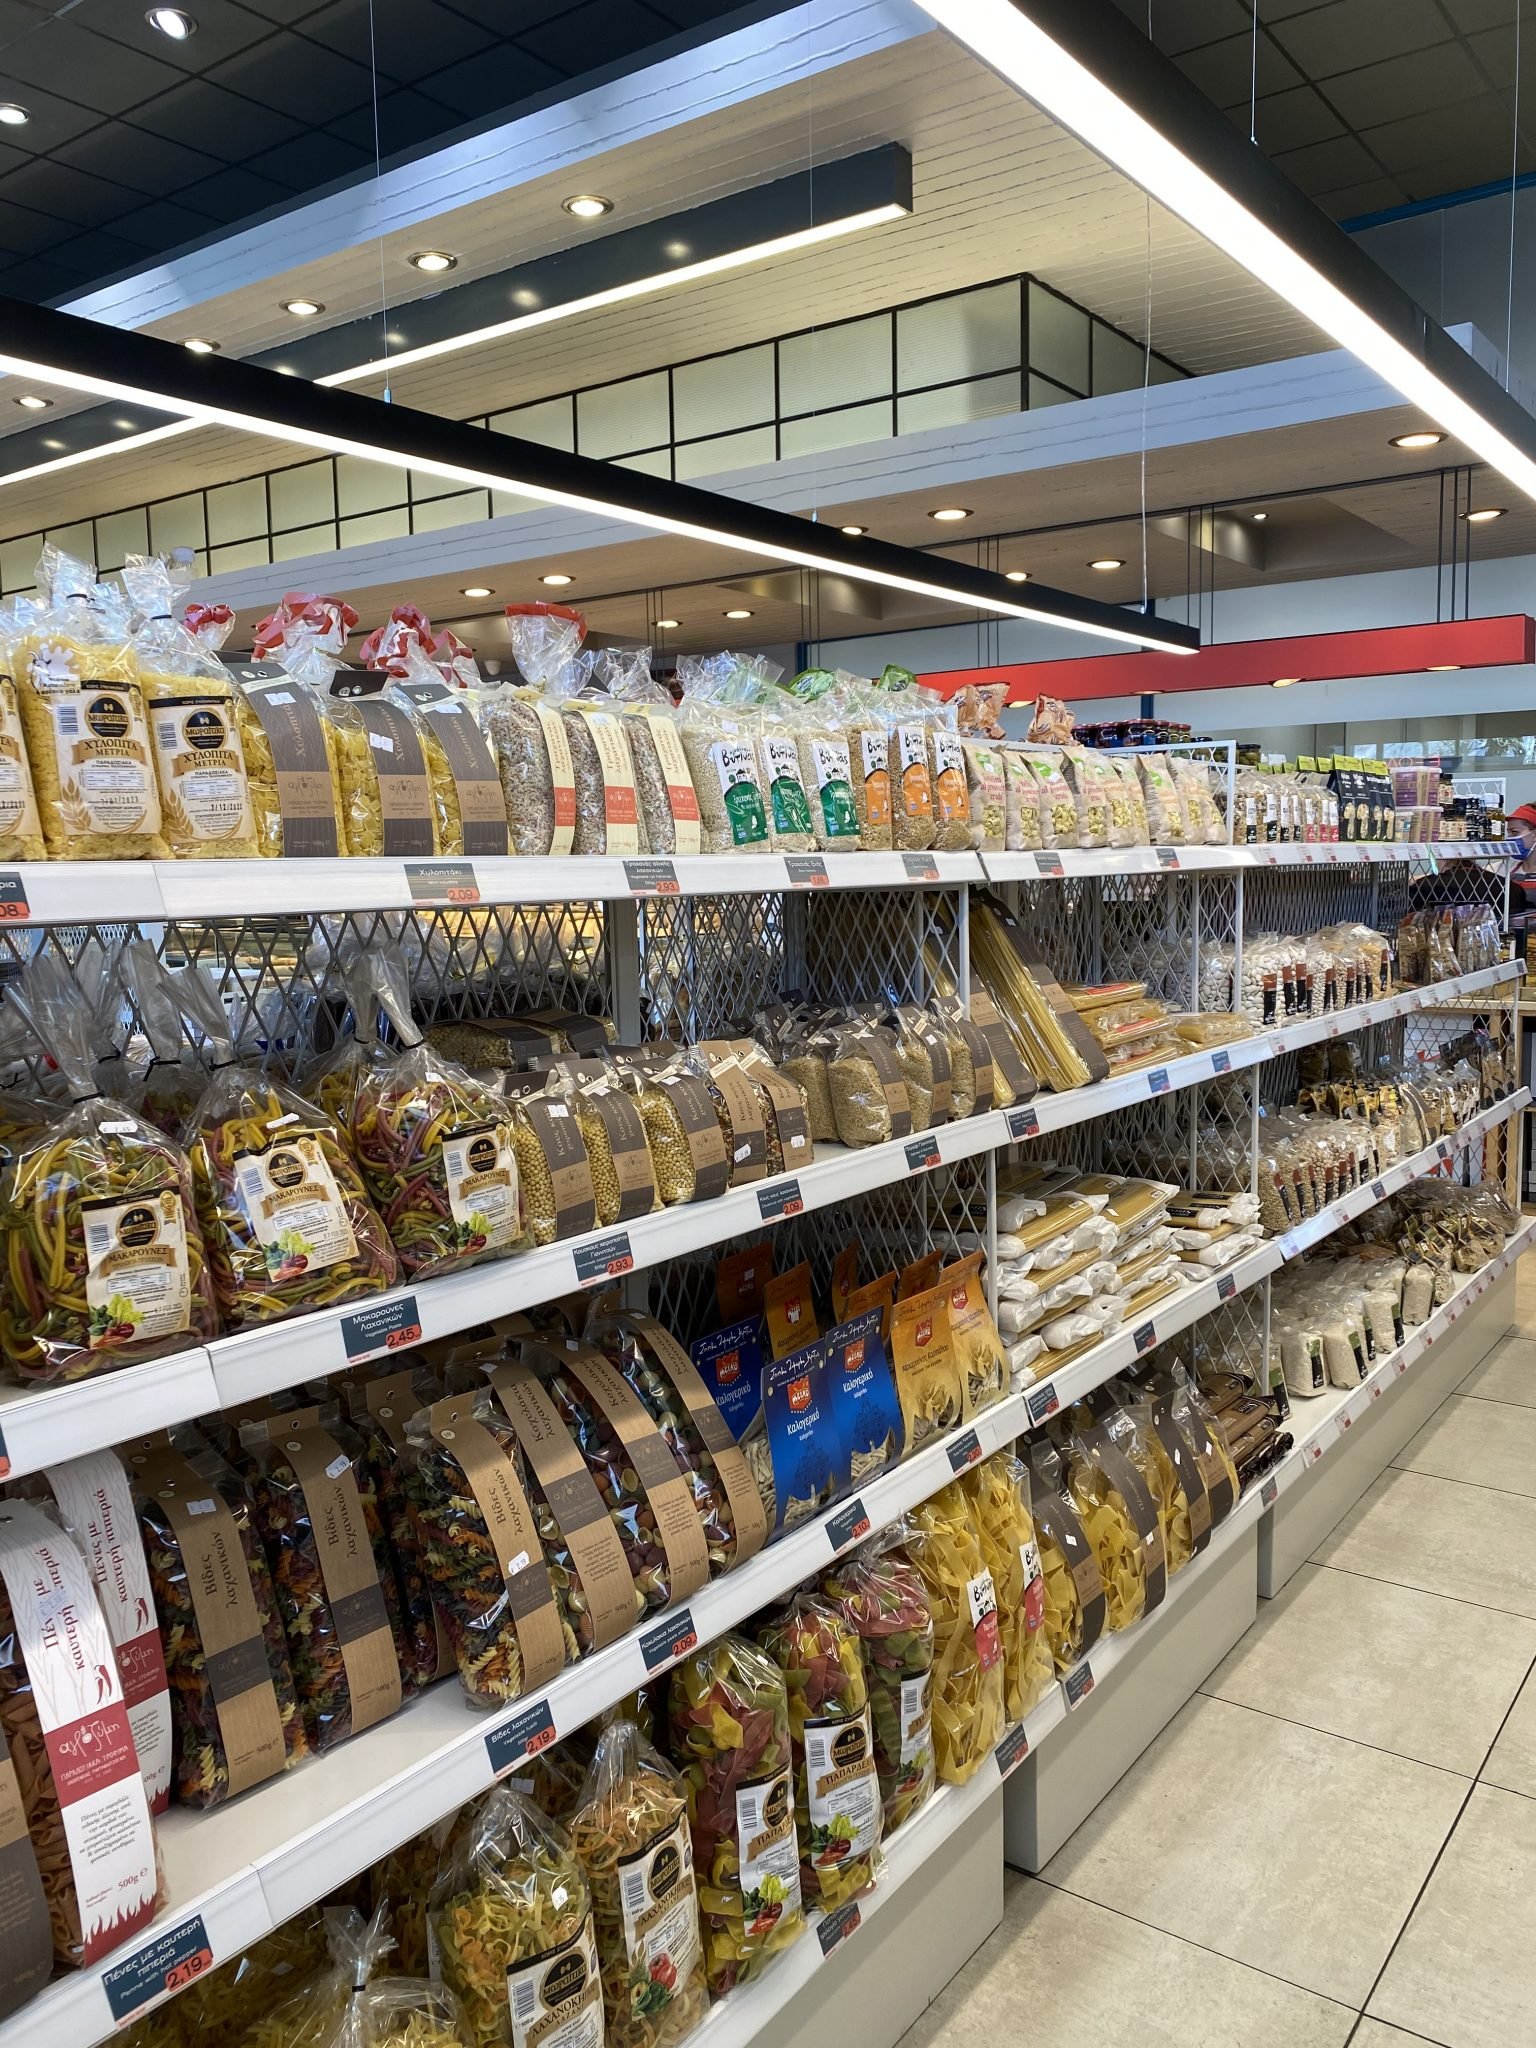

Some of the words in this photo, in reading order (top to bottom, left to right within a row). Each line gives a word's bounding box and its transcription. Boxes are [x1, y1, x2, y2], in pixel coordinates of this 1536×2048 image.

[85, 738, 138, 751] ΧΥΛΟΠΙΤΑ
[96, 749, 130, 757] ΜΕΤΡΙΑ
[184, 750, 233, 763] ΧΥΛΟΠΙΤΑ
[194, 759, 226, 768] ΜΕΤΡΙΑ
[419, 868, 463, 878] Χυλοπιτάκι
[449, 889, 473, 901] 2,09
[656, 882, 675, 892] 2,93
[269, 1184, 320, 1203] ΜΑΚΑΡΟΥΝΕΣ
[784, 1201, 800, 1215] 2,09
[108, 1247, 168, 1262] ΜΑΚΑΡΟΥΝΕΣ
[608, 1258, 629, 1274] 2,93
[353, 1303, 404, 1325] Μακαρούνες
[360, 1312, 403, 1332] Λαχανικών
[364, 1328, 388, 1338] Vegetable
[388, 1322, 402, 1330] Pasta
[387, 1327, 415, 1347] 2,45
[579, 1359, 620, 1407] Κοχυλάκια
[842, 1367, 874, 1393] Καλογερικό
[715, 1381, 751, 1406] Καλογερικό
[510, 1382, 543, 1443] Κοχυλάκια
[520, 1380, 556, 1437] λαχανικών
[786, 1408, 820, 1435] Καλογερικό
[489, 1487, 506, 1526] Βίδες
[493, 1467, 524, 1536] λαχανικών
[93, 1488, 116, 1544] πιπεριά
[324, 1507, 340, 1547] Βίδες
[335, 1486, 358, 1559] λαχανικών
[87, 1520, 102, 1538] με
[852, 1521, 867, 1538] 2,10
[92, 1538, 108, 1584] Πένες
[212, 1530, 238, 1608] λαχανικών
[105, 1544, 128, 1603] καυτερή
[201, 1553, 218, 1596] Βίδες
[33, 1578, 52, 1596] με
[57, 1603, 85, 1671] καυτερή
[673, 1636, 692, 1656] 2,09
[491, 1727, 511, 1743] Βίδες
[511, 1706, 544, 1730] λαχανικών
[102, 1745, 129, 1763] ΤΡΟΦΙΜΑ
[527, 1730, 550, 1754] 2,19
[118, 1874, 139, 1890] 500g
[104, 1960, 138, 1985] Πένες
[140, 1948, 155, 1965] με
[156, 1919, 200, 1953] καυτερή
[136, 1948, 176, 1978] πιπεριά
[120, 1981, 144, 1999] Penne
[144, 1971, 159, 1983] with
[160, 1963, 172, 1973] hot
[173, 1945, 198, 1966] pepper
[167, 1956, 202, 1989] 2,19
